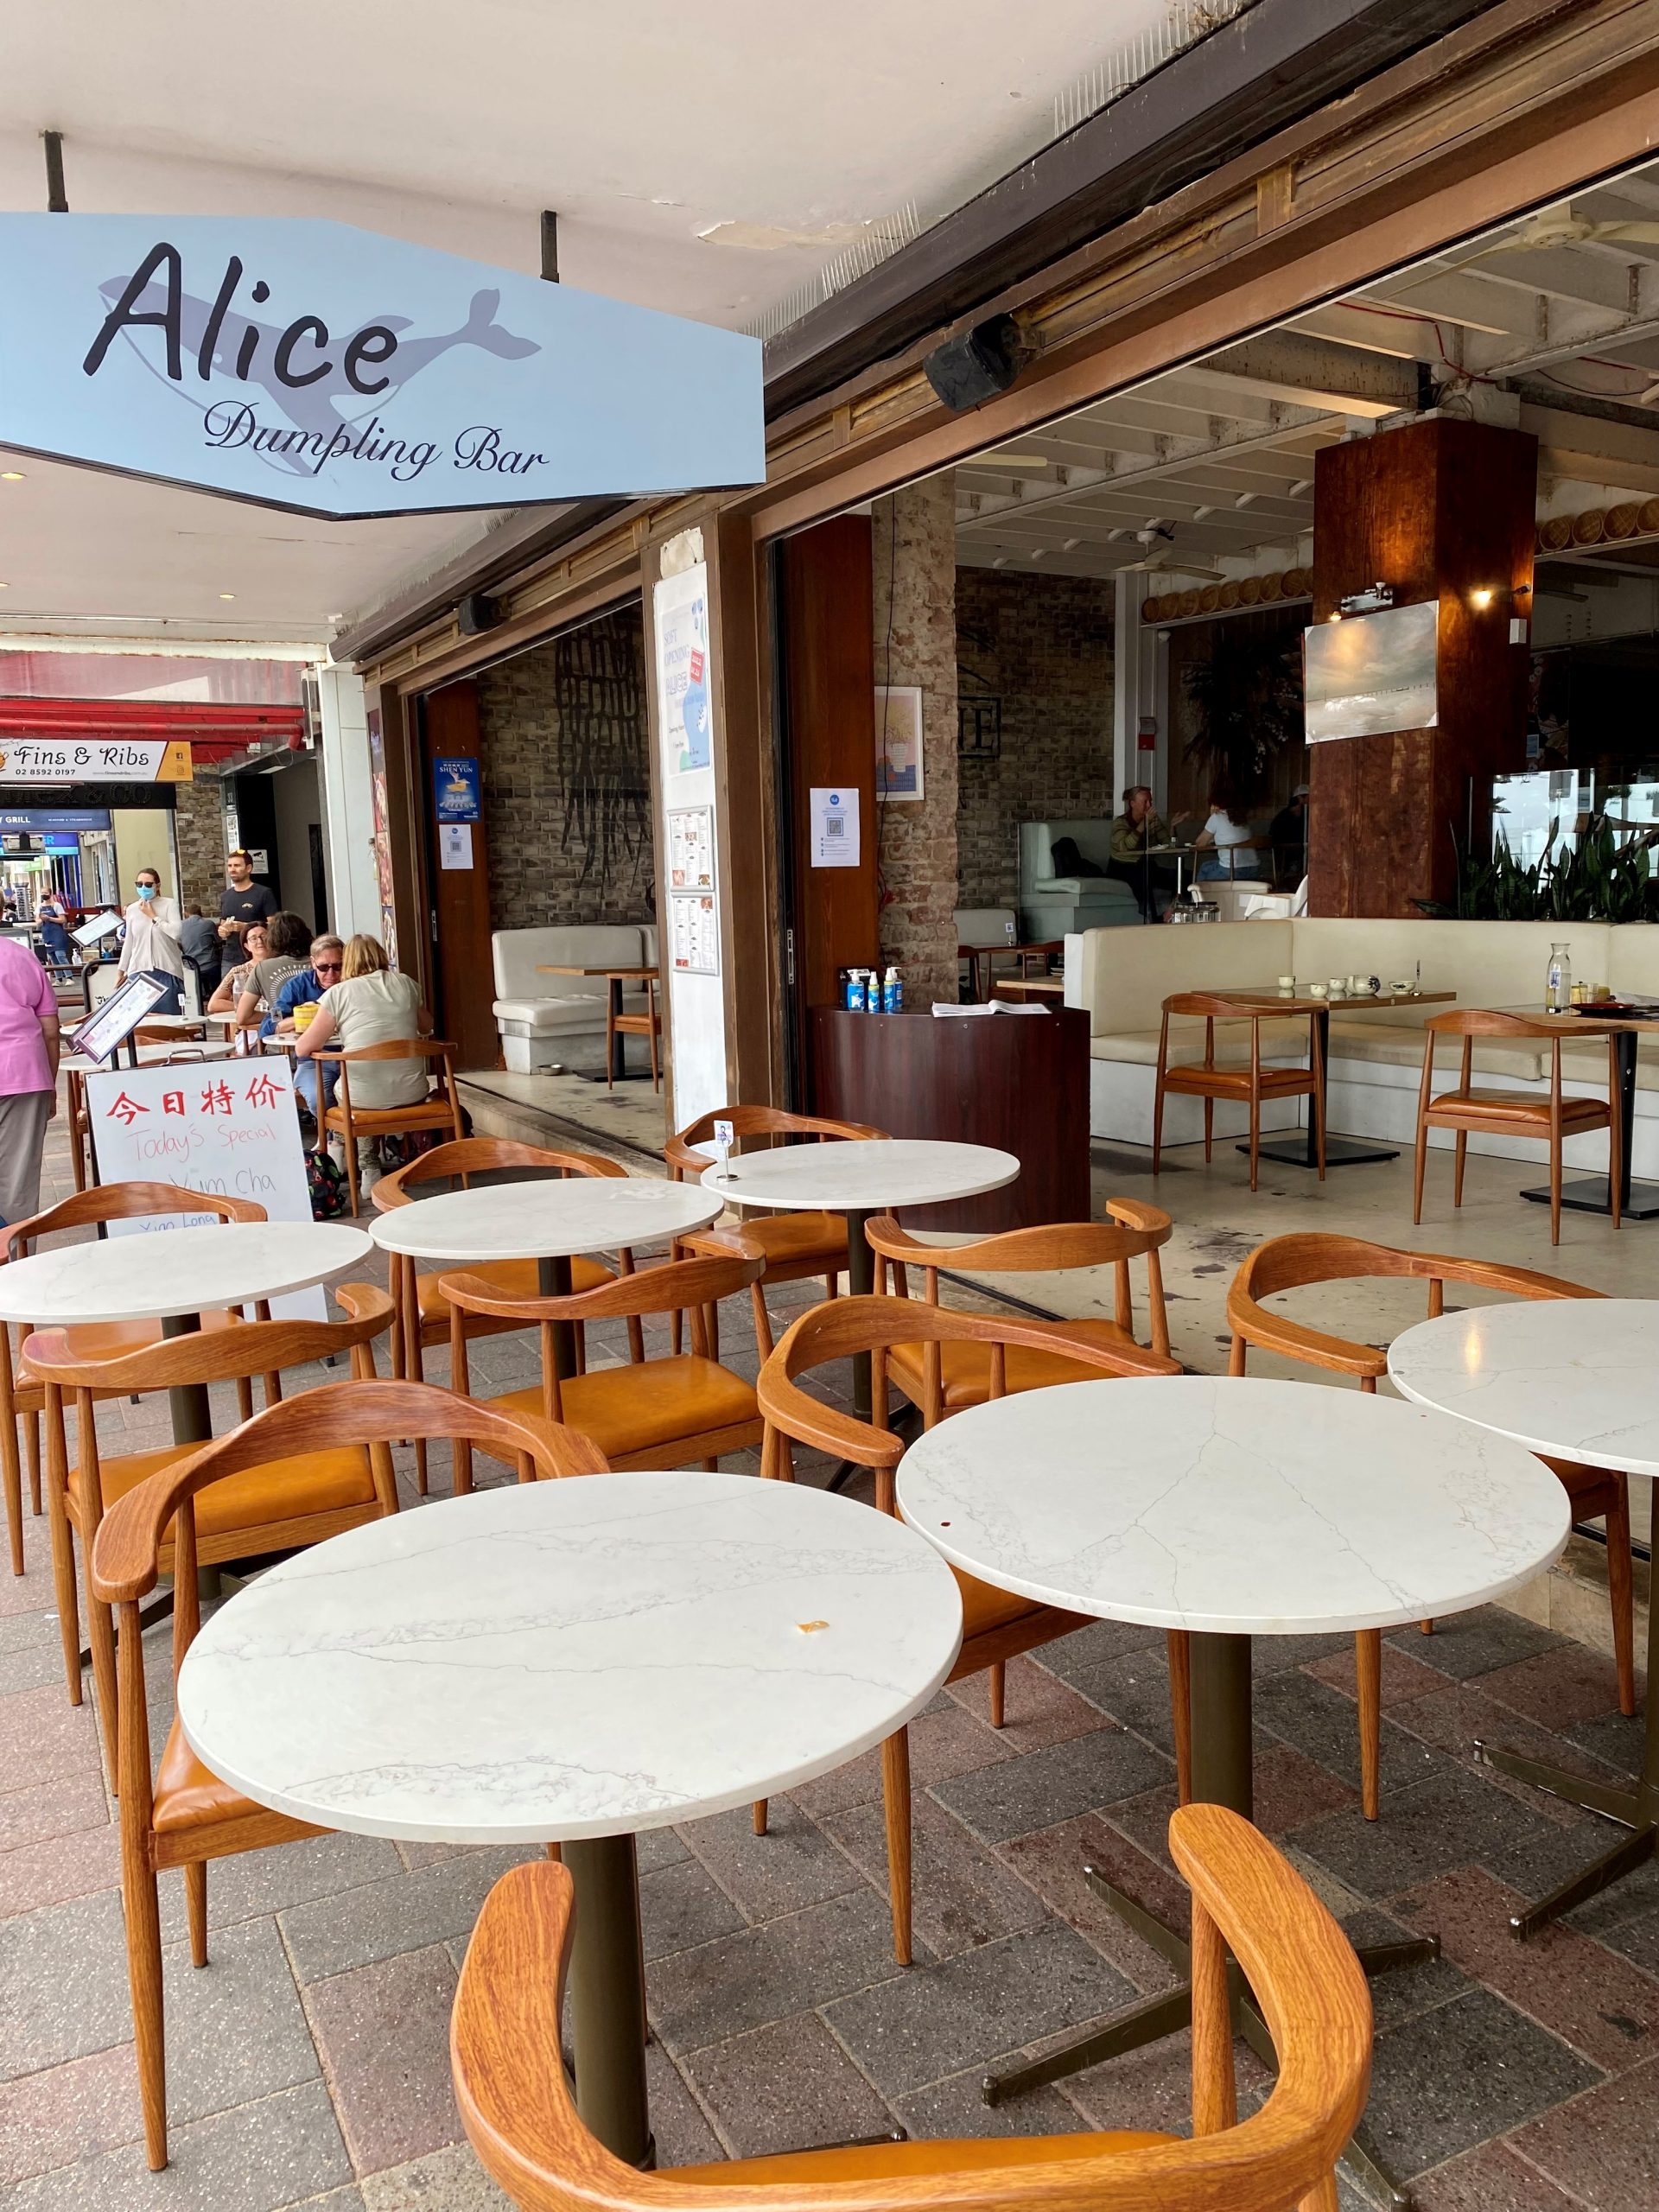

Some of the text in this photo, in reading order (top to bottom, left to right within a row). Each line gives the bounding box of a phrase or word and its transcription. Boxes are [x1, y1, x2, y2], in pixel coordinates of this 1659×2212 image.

[82, 242, 398, 395] Alice
[203, 400, 550, 481] Dumpling Bar
[14, 746, 149, 767] Fins & Ribs
[106, 1073, 287, 1125] 今日特价
[127, 1122, 276, 1163] Today's Special
[235, 1167, 276, 1194] Cha
